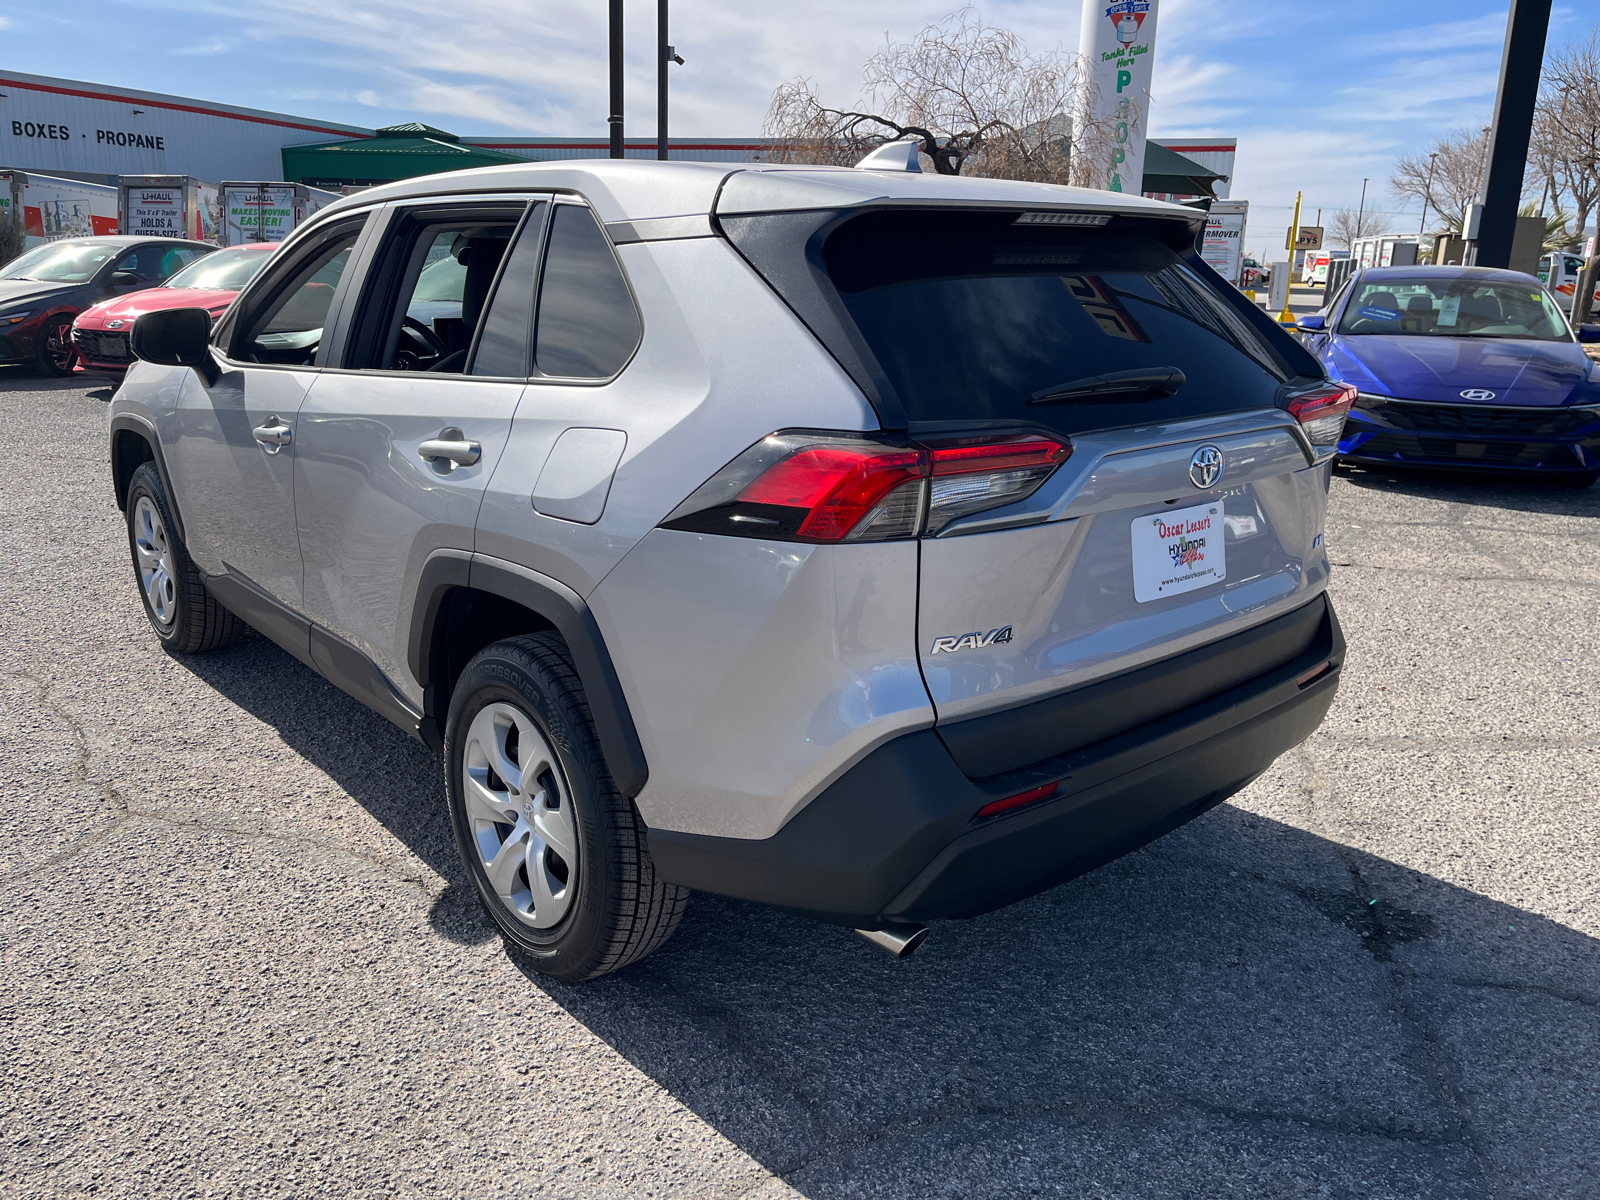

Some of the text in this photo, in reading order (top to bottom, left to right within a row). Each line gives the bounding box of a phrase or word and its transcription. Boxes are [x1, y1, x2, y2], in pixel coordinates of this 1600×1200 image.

[1110, 4, 1127, 13] OPEN
[1101, 43, 1149, 62] Tanks Filled
[1116, 57, 1135, 69] Here
[11, 120, 165, 151] BOXES PROPANE
[231, 207, 258, 216] MAKES
[141, 218, 173, 228] HOLDS A
[135, 229, 178, 238] QUEEN-SIZE
[1158, 515, 1211, 539] Oscar Leeser's
[1168, 537, 1206, 556] HYUNDAI
[930, 624, 1014, 655] RAV4
[478, 664, 540, 706] CROSSOVER
